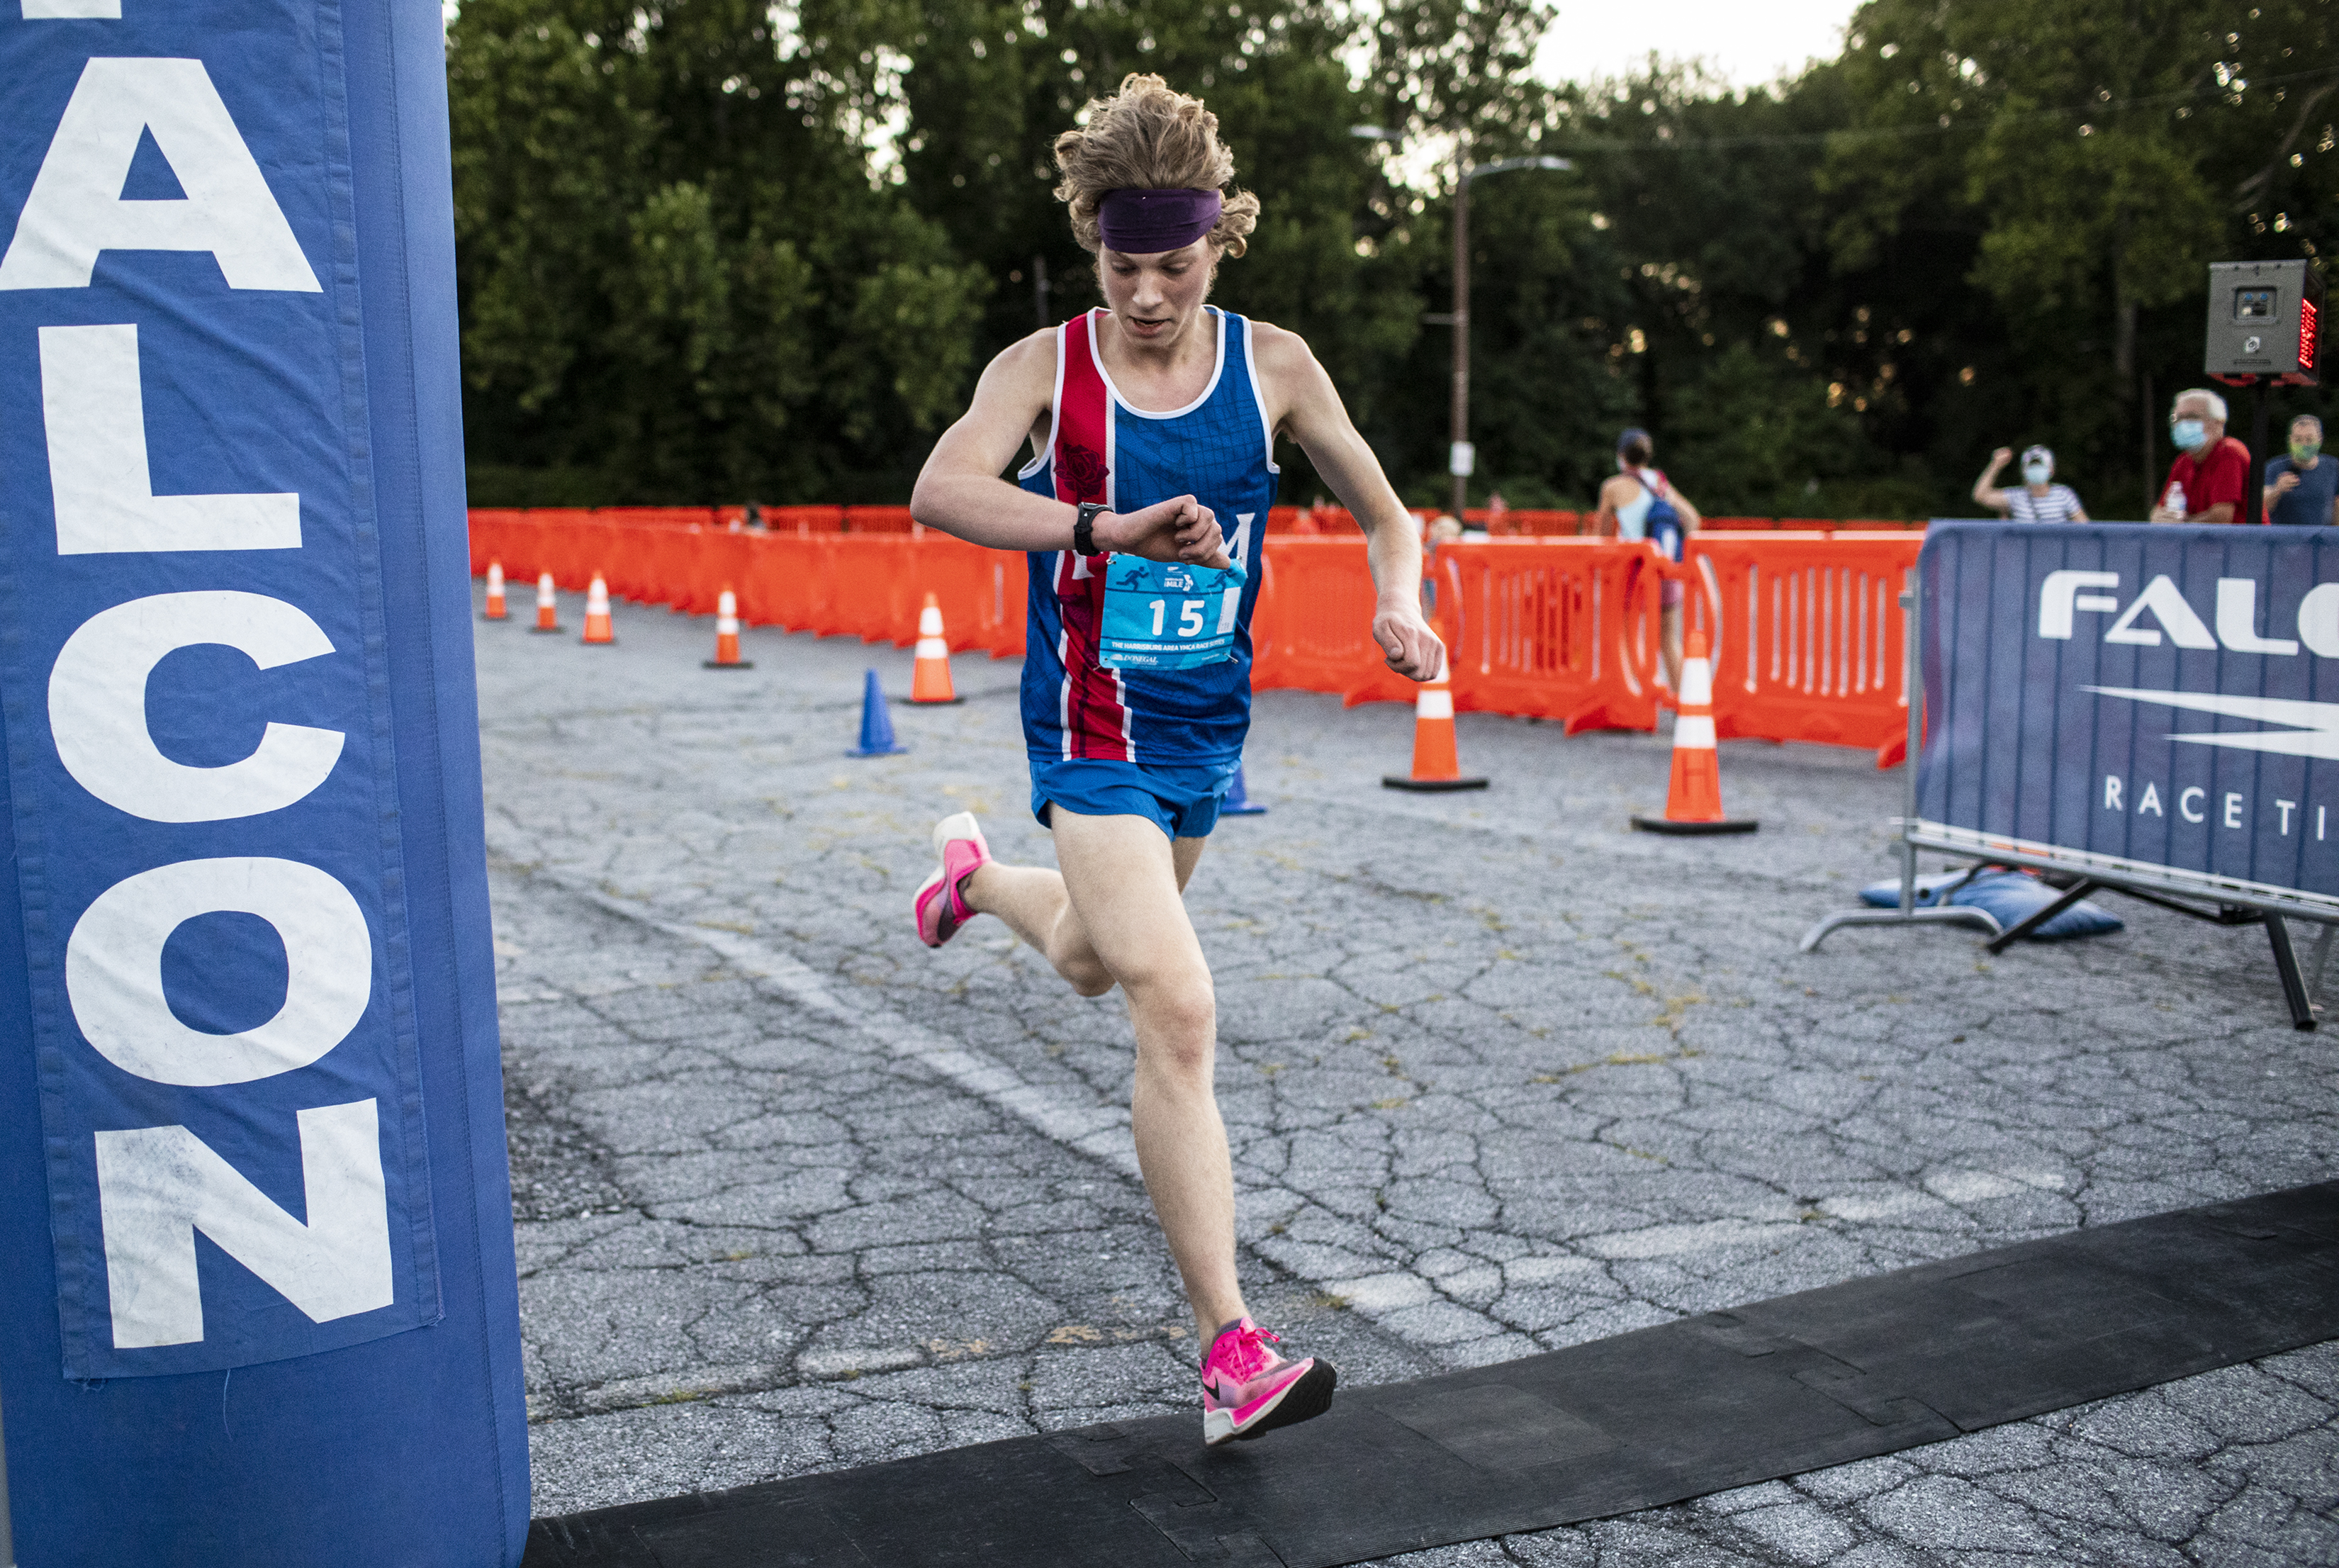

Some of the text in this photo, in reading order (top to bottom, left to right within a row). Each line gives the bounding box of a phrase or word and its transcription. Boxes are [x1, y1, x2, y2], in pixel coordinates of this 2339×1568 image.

[1149, 599, 1205, 637] 15
[1123, 642, 1162, 651] HARRISBURG
[0, 0, 393, 1348] ALCON
[2104, 774, 2326, 841] RACE TI
